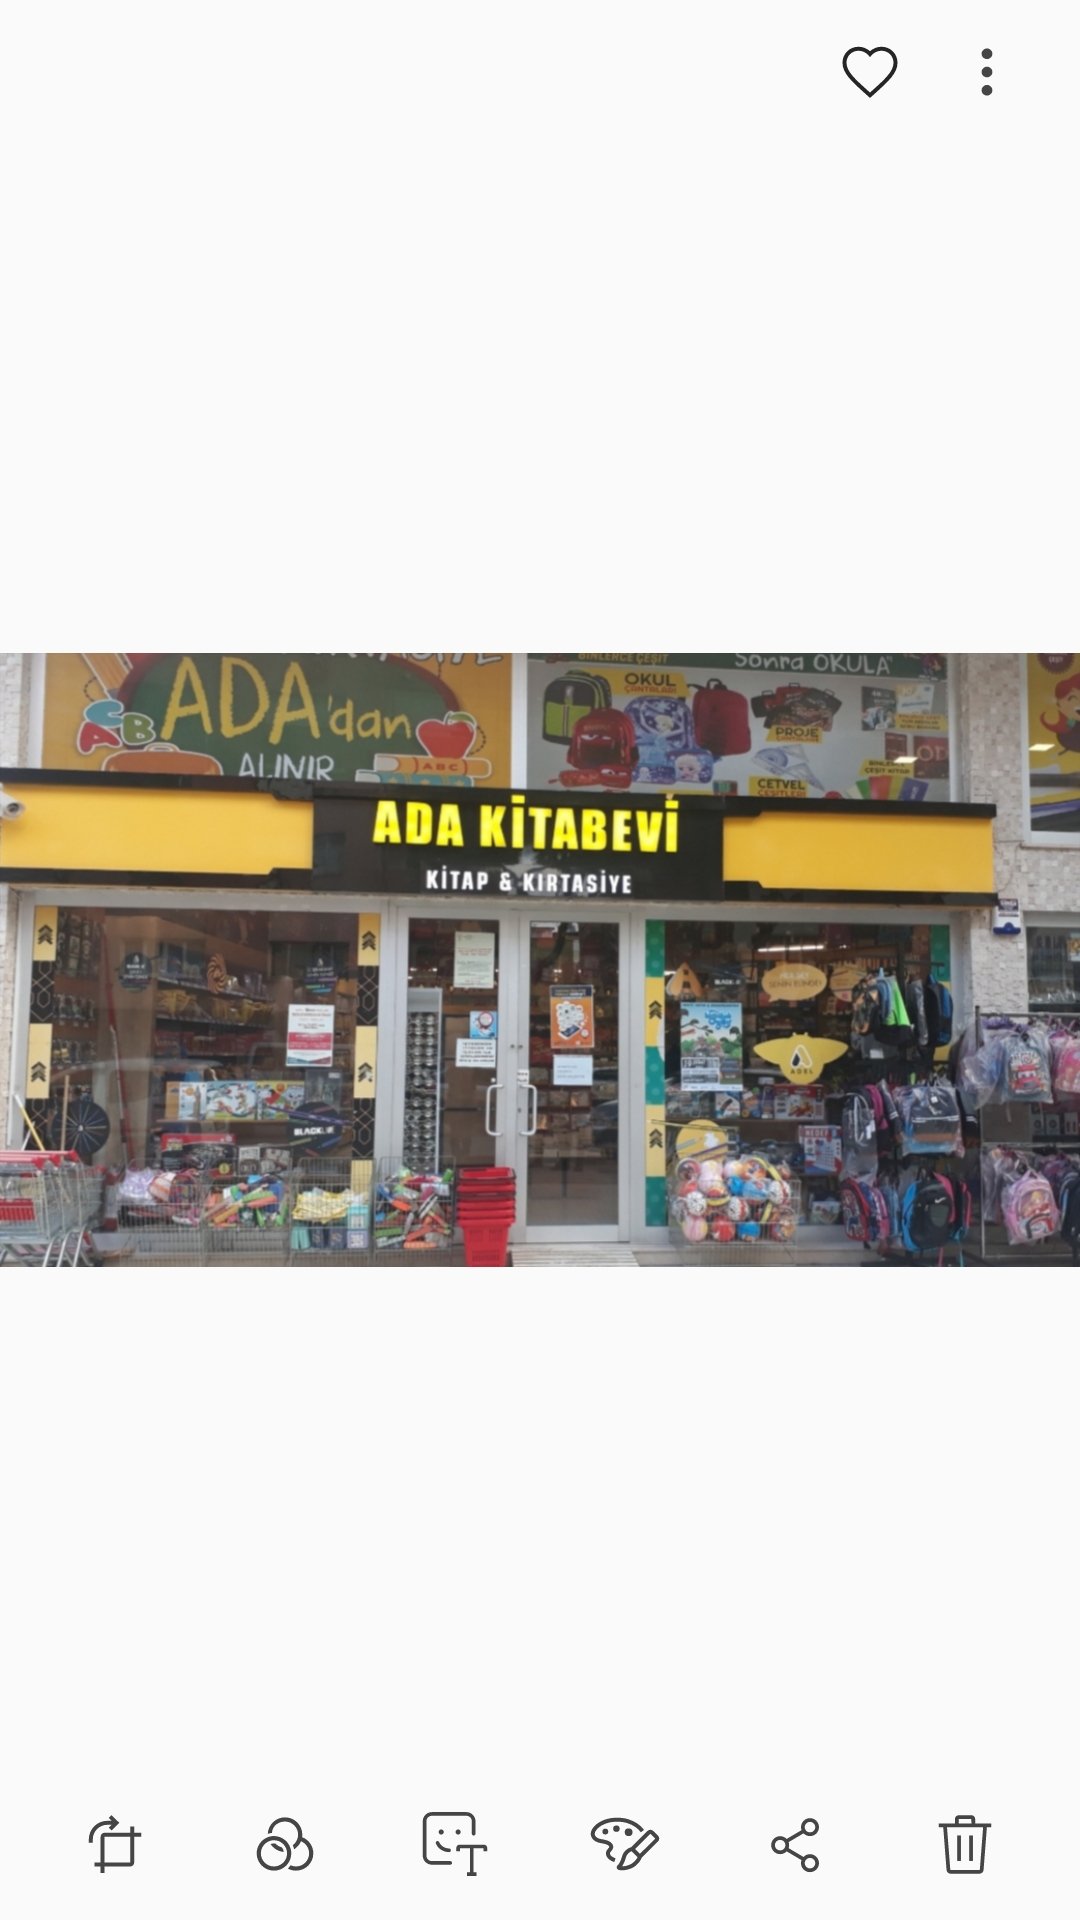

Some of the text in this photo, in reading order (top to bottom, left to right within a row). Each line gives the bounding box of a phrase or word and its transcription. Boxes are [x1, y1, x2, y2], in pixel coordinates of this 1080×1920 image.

[624, 672, 676, 687] OKUL
[775, 726, 819, 738] PROJE
[239, 753, 334, 781] ALINIR
[422, 763, 458, 772] ABC
[757, 778, 806, 790] CETVEL
[373, 795, 679, 853] ADA KİTABEVİ
[426, 866, 632, 894] KİTAP & KIRTASİYE
